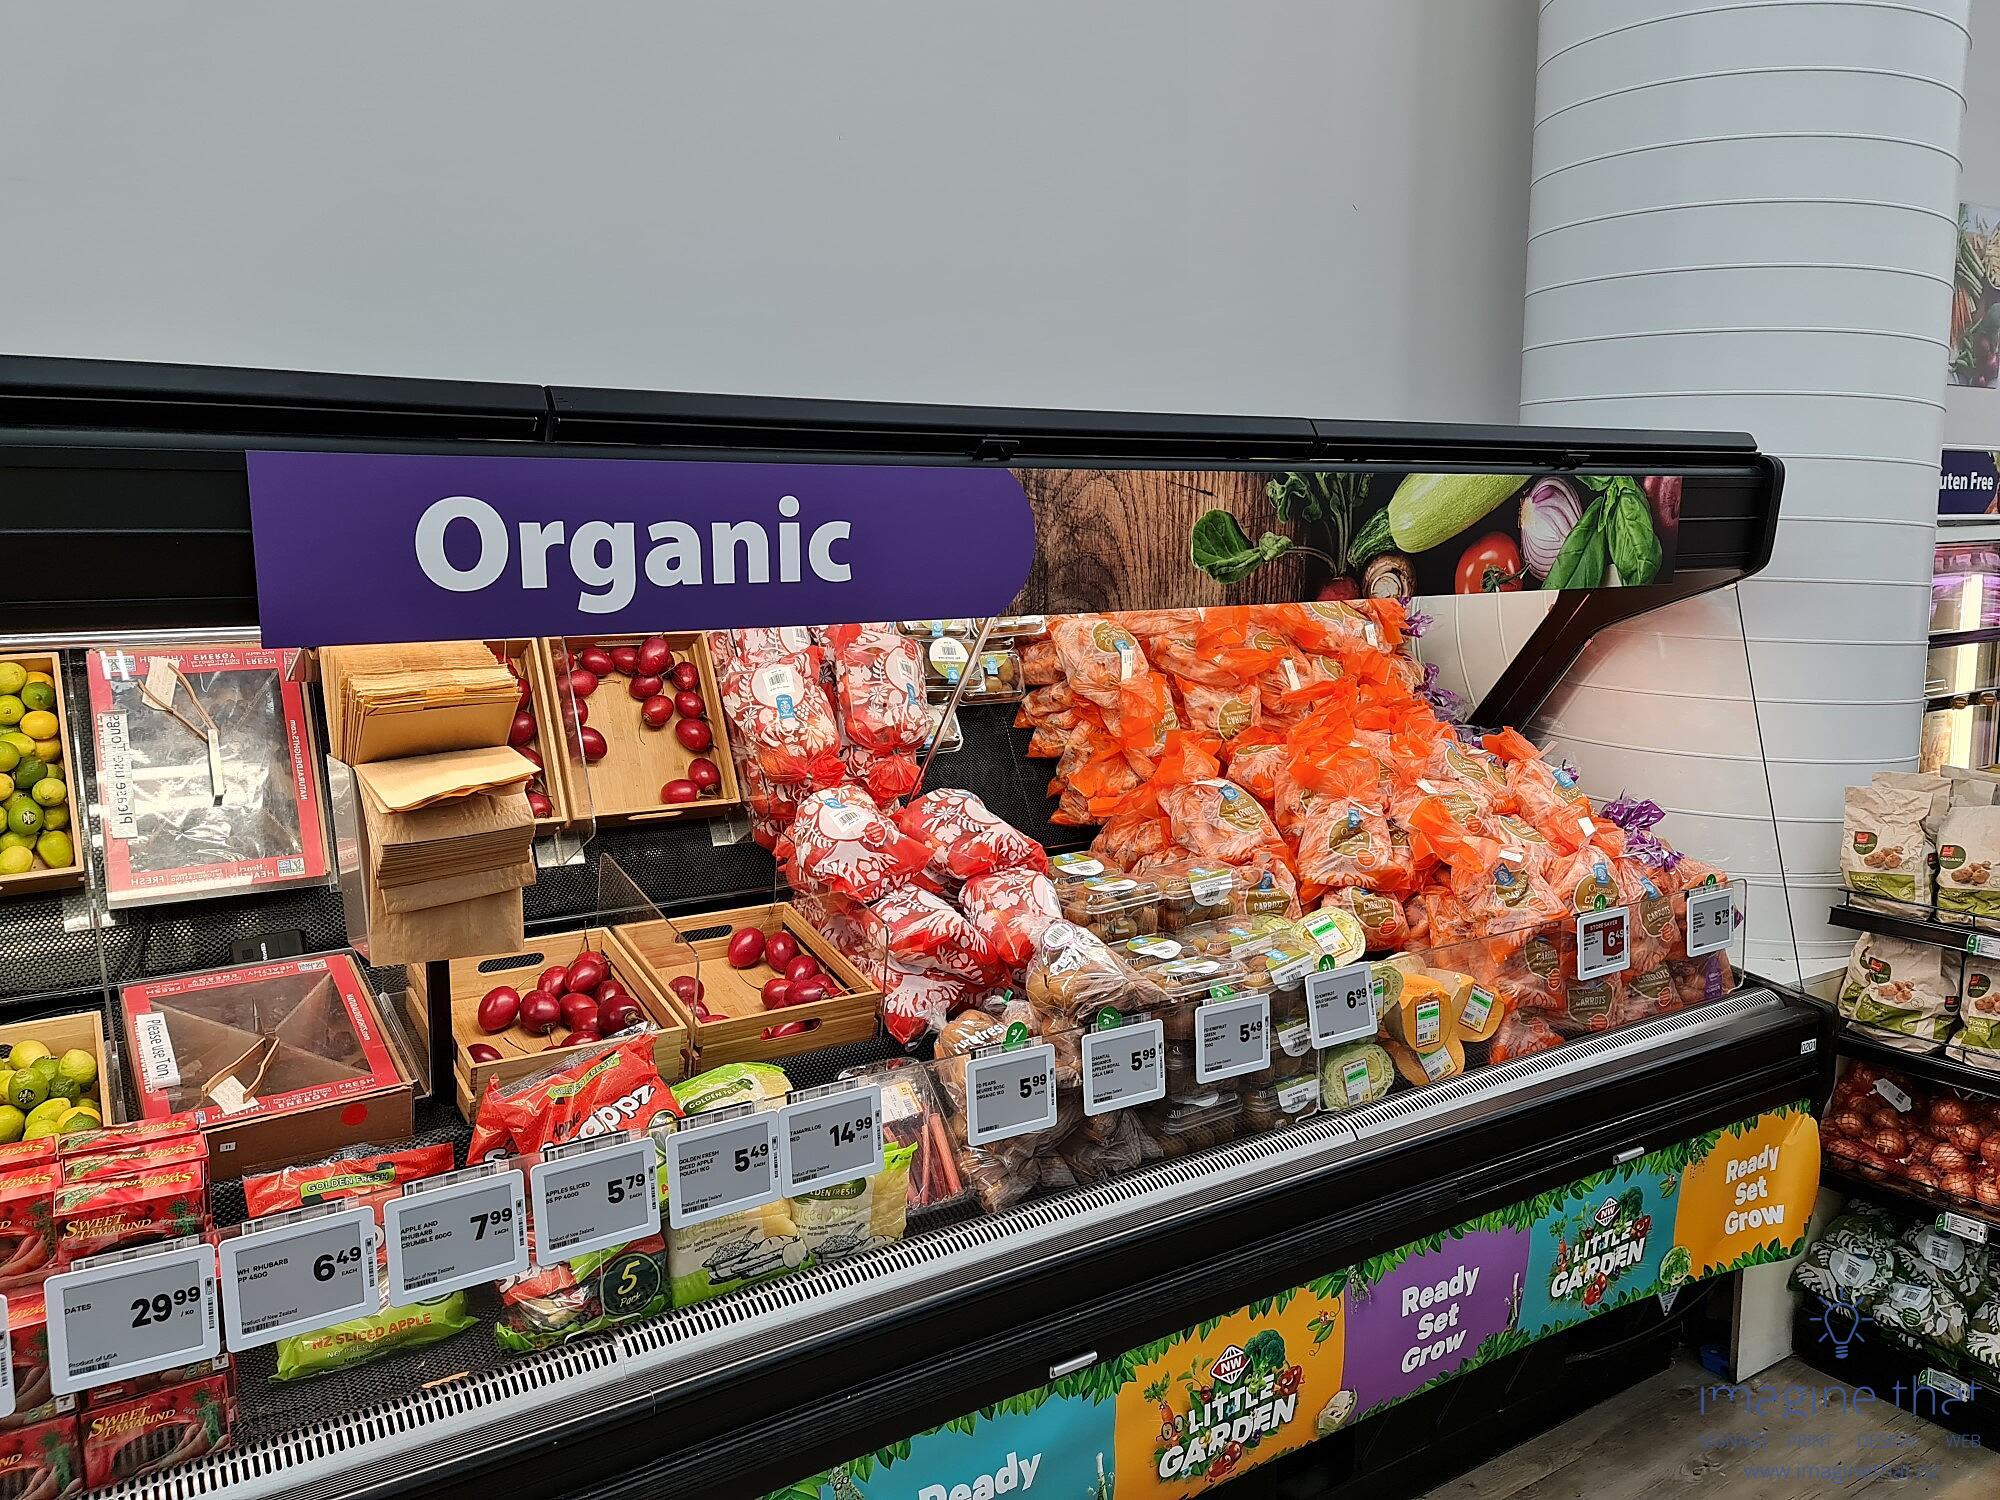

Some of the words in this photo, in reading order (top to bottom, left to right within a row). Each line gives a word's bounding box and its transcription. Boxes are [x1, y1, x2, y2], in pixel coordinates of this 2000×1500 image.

[1940, 473, 1968, 490] uten
[1971, 472, 1994, 490] Free
[415, 495, 852, 614] Organic
[1589, 884, 1613, 894] Organic
[1254, 900, 1284, 911] CARROTS
[1364, 898, 1389, 911] CARROTS
[1647, 905, 1671, 921] CARROTS
[1590, 923, 1603, 931] STORE
[1604, 920, 1618, 928] SAVER
[1608, 930, 1624, 947] 649
[1638, 969, 1670, 982] CARROTS
[1347, 988, 1367, 1009] 699
[1576, 996, 1606, 1006] CARROTS
[145, 1019, 163, 1044] Please
[1240, 1020, 1262, 1042] 549
[152, 1044, 166, 1059] use
[1131, 1048, 1156, 1071] 599
[154, 1057, 172, 1080] Ton
[339, 1078, 375, 1090] FRESH
[1020, 1074, 1047, 1098] 599
[278, 1092, 329, 1109] ENERGY
[689, 1091, 723, 1109] GOLDEN
[790, 1123, 821, 1136] TAMARILLOS
[829, 1117, 872, 1147] 1499
[679, 1155, 702, 1165] GOLDEN
[702, 1150, 720, 1159] FRESH
[679, 1162, 696, 1172] DICED
[696, 1158, 714, 1167] APPLE
[734, 1143, 769, 1173] 549
[1725, 1143, 1780, 1186] Ready
[307, 1177, 355, 1192] GOLDEN
[355, 1172, 390, 1184] FRESH
[680, 1169, 699, 1178] POUCH
[545, 1186, 569, 1198] APPLES
[569, 1181, 591, 1191] SLICED
[607, 1173, 646, 1204] 579
[832, 1186, 857, 1196] FRESH
[1734, 1176, 1769, 1206] Set
[682, 1200, 695, 1208] Product
[708, 1193, 723, 1201] Zealand
[1600, 1206, 1616, 1217] NW
[1724, 1204, 1785, 1236] Grow
[63, 1212, 128, 1241] SWEET
[78, 1219, 152, 1241] TAMARIND
[401, 1224, 422, 1235] APPLE
[423, 1220, 438, 1229] AND
[470, 1207, 513, 1241] 799
[494, 1228, 509, 1236] EACH
[401, 1228, 433, 1242] RHUBARB
[401, 1236, 434, 1249] CRUMBLE
[549, 1234, 565, 1243] Product
[578, 1227, 595, 1235] Zealand
[1572, 1220, 1637, 1264] LITTLE
[237, 1267, 250, 1277] WH
[253, 1258, 289, 1272] RHUBARB
[313, 1247, 362, 1282] 649
[342, 1267, 358, 1276] EACH
[404, 1275, 420, 1283] Product
[438, 1265, 455, 1274] Zealand
[1550, 1237, 1646, 1300] GARDEN
[238, 1275, 247, 1283] PP
[618, 1260, 641, 1295] 5
[1401, 1263, 1480, 1318] Ready
[65, 1303, 92, 1315] DATES
[130, 1286, 201, 1328] 2999
[620, 1293, 641, 1308] Pack
[242, 1318, 260, 1327] Product
[267, 1313, 278, 1321] New
[279, 1308, 298, 1316] Zealand
[1416, 1302, 1459, 1341] Set
[312, 1336, 332, 1350] NZ
[336, 1327, 385, 1345] SLICED
[388, 1313, 431, 1335] APPLE
[69, 1360, 94, 1369] Product
[102, 1353, 118, 1361] USA
[327, 1348, 340, 1358] NO
[1400, 1329, 1467, 1375] Grow
[1218, 1356, 1243, 1377] NW
[1187, 1373, 1277, 1436] LITTLE
[88, 1404, 152, 1440] SWEET
[103, 1409, 176, 1438] TAMARIND
[1158, 1394, 1297, 1480] GARDEN
[917, 1452, 1043, 1500] Ready
